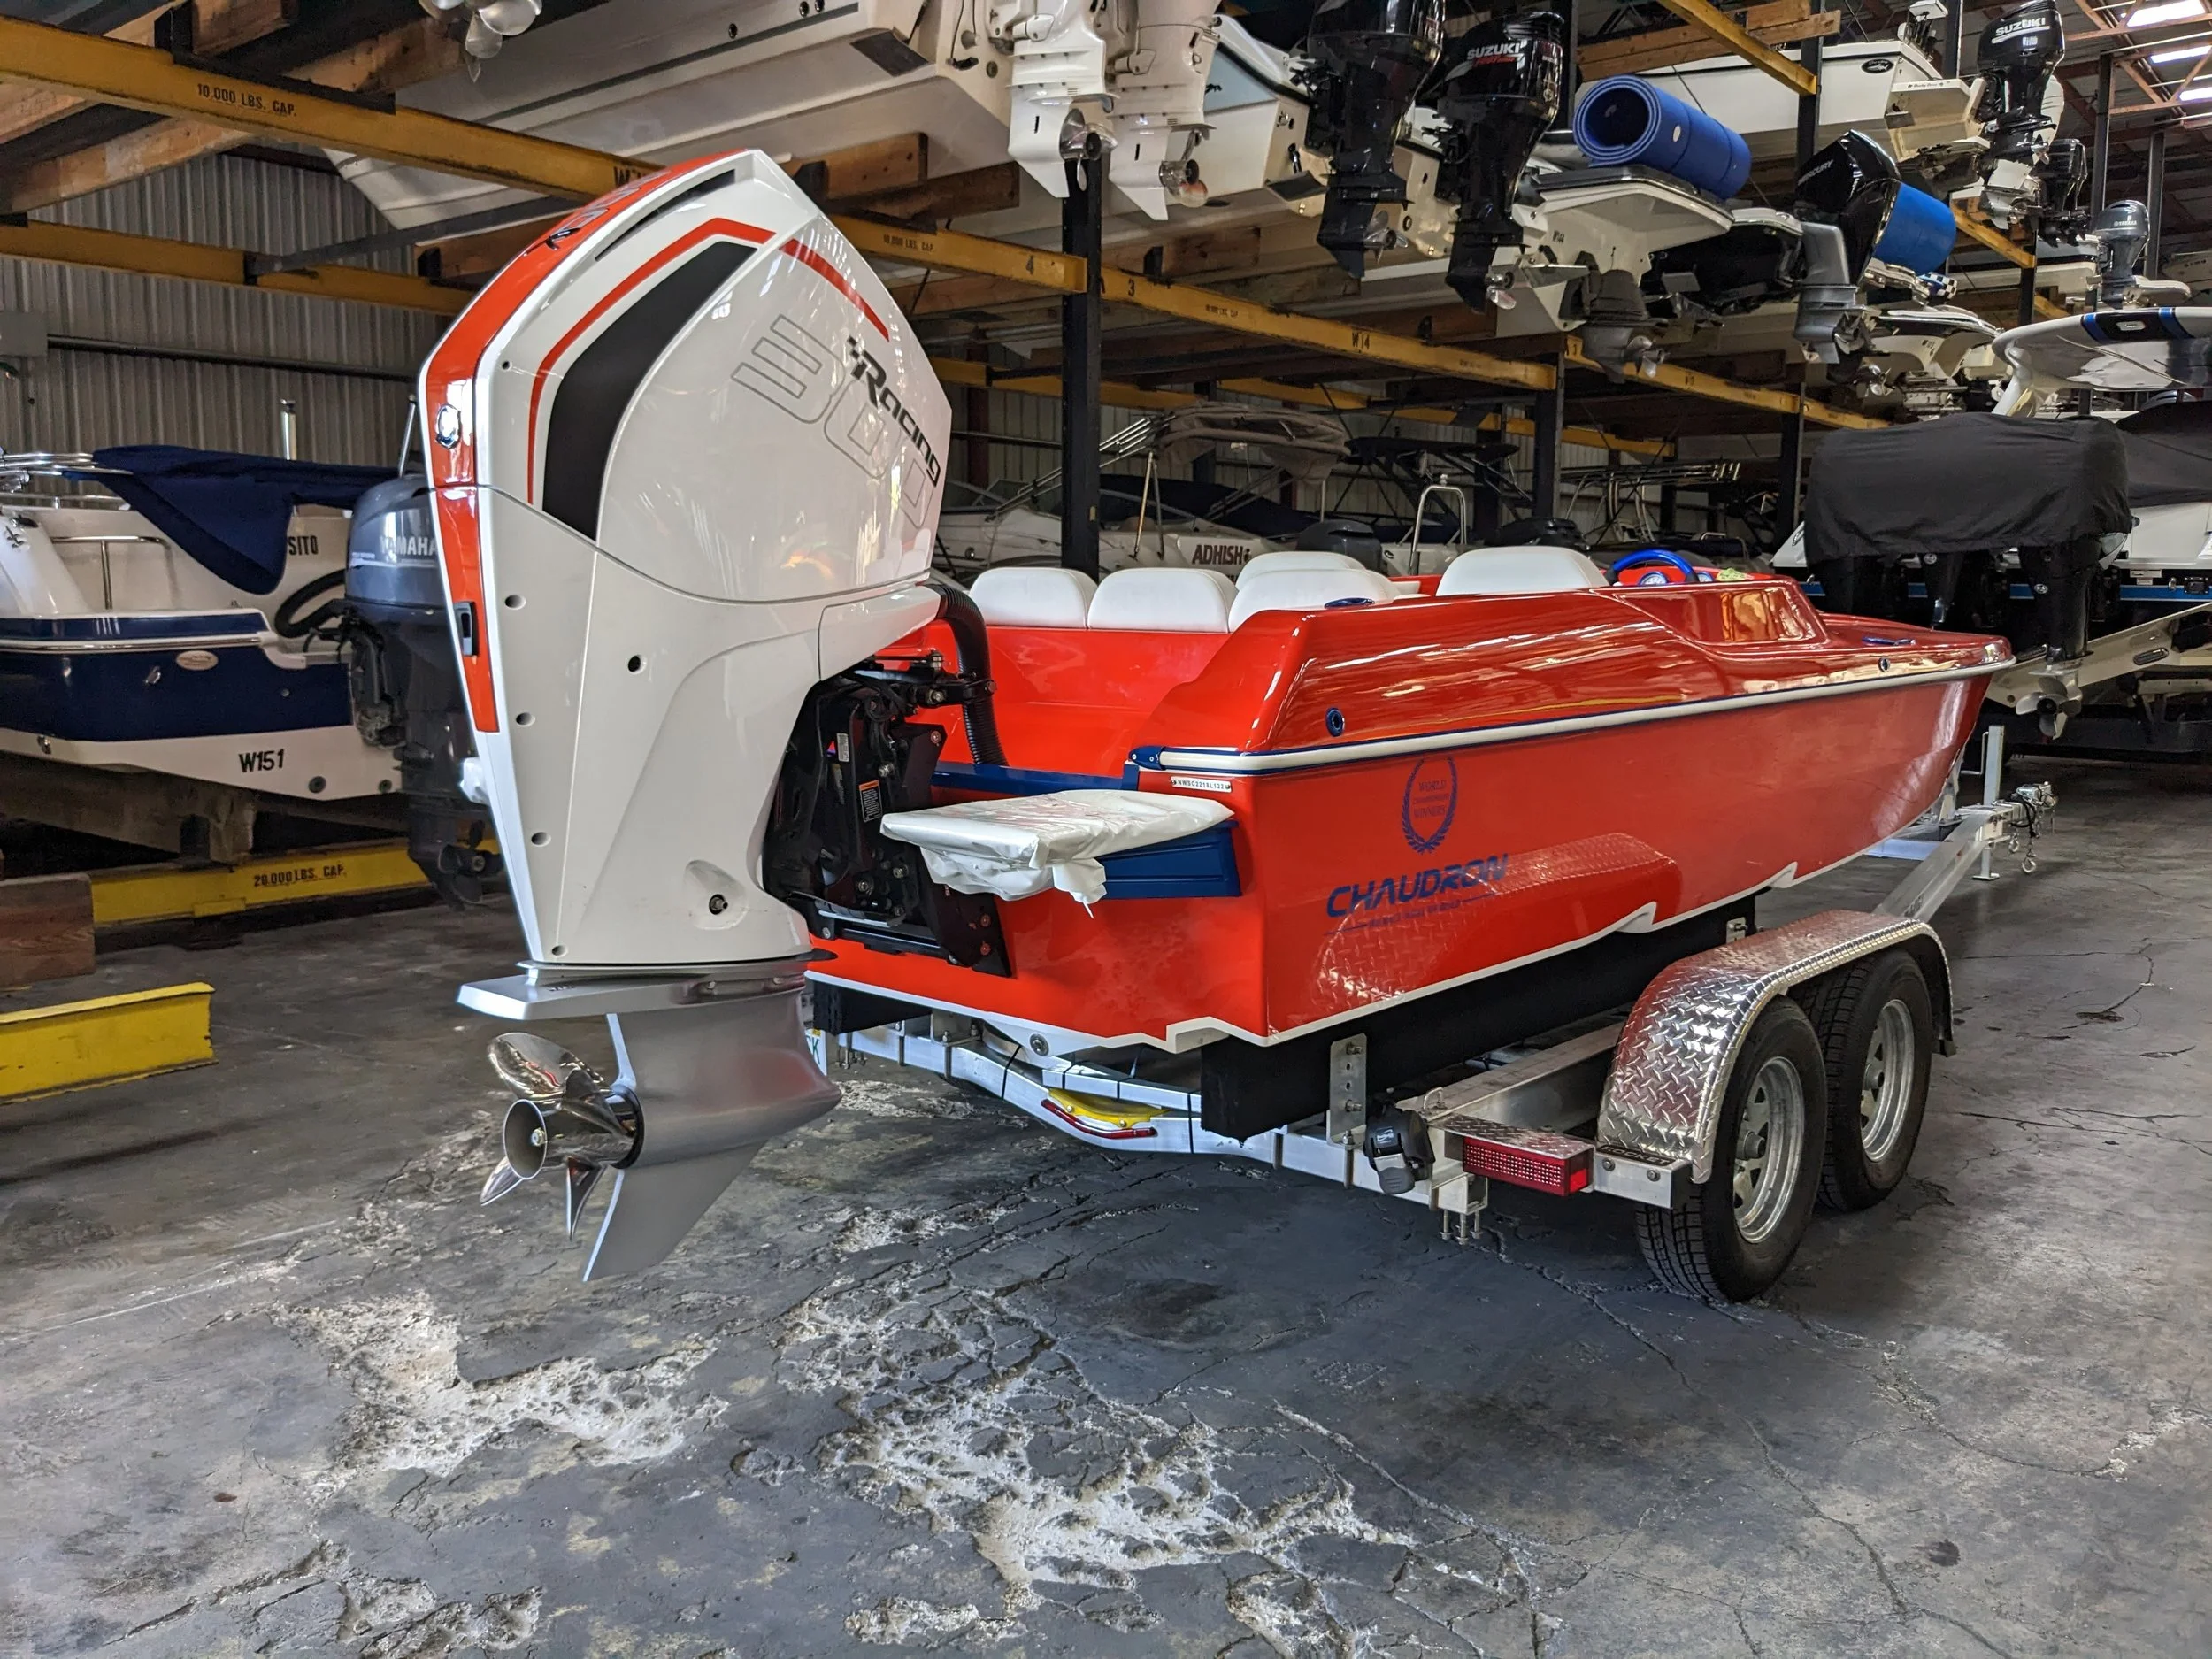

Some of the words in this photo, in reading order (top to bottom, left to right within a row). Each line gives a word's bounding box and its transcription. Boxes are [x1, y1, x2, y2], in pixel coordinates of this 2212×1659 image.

[1995, 17, 2046, 36] SUZUKI
[1467, 42, 1521, 60] SUZUKI
[241, 92, 266, 110] LBS.
[273, 99, 296, 117] CAP.
[1025, 255, 1034, 275] 4
[1127, 277, 1135, 297] 3
[380, 535, 439, 557] YAMAHA
[1192, 544, 1243, 565] ADHISH
[238, 749, 284, 773] W151
[1327, 853, 1509, 918] CHAUDRON
